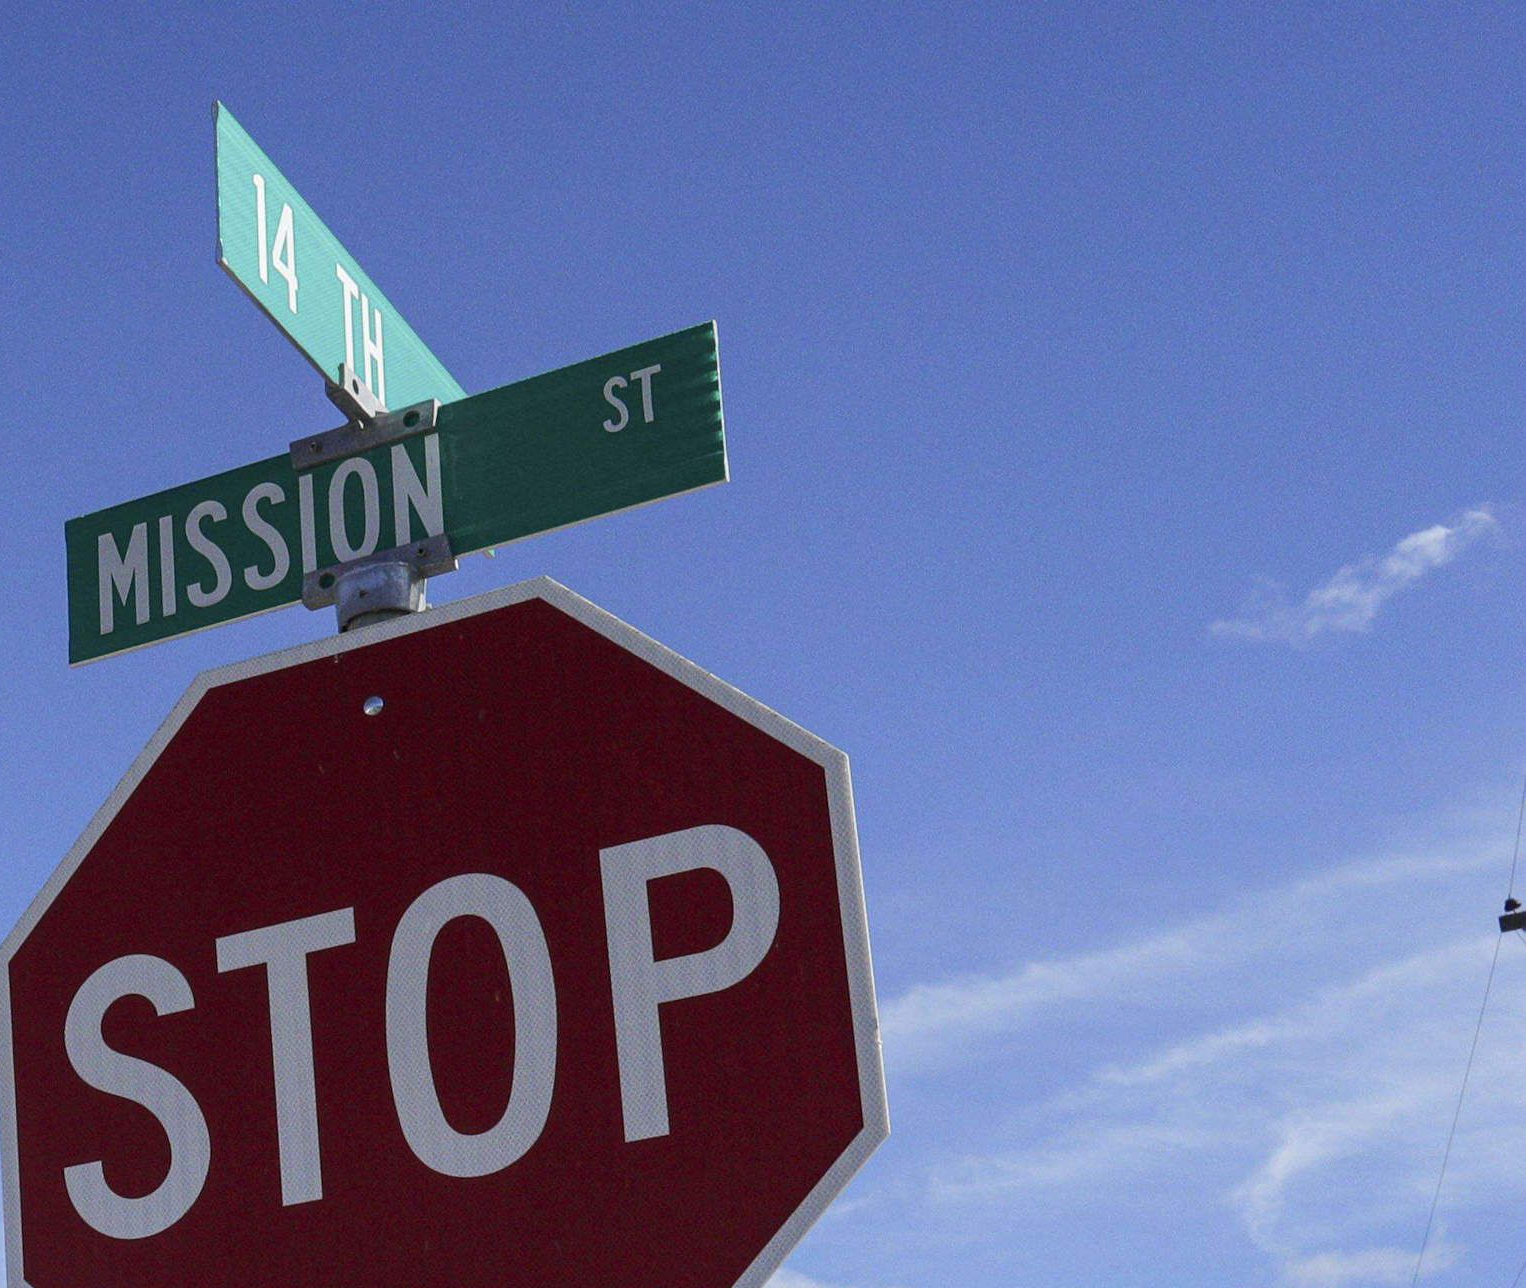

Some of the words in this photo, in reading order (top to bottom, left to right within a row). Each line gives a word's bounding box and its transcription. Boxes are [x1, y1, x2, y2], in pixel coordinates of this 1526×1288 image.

[253, 173, 299, 315] 14
[335, 262, 387, 408] TH
[96, 433, 446, 635] MISSION
[602, 363, 661, 434] ST
[63, 823, 781, 1241] STOP
